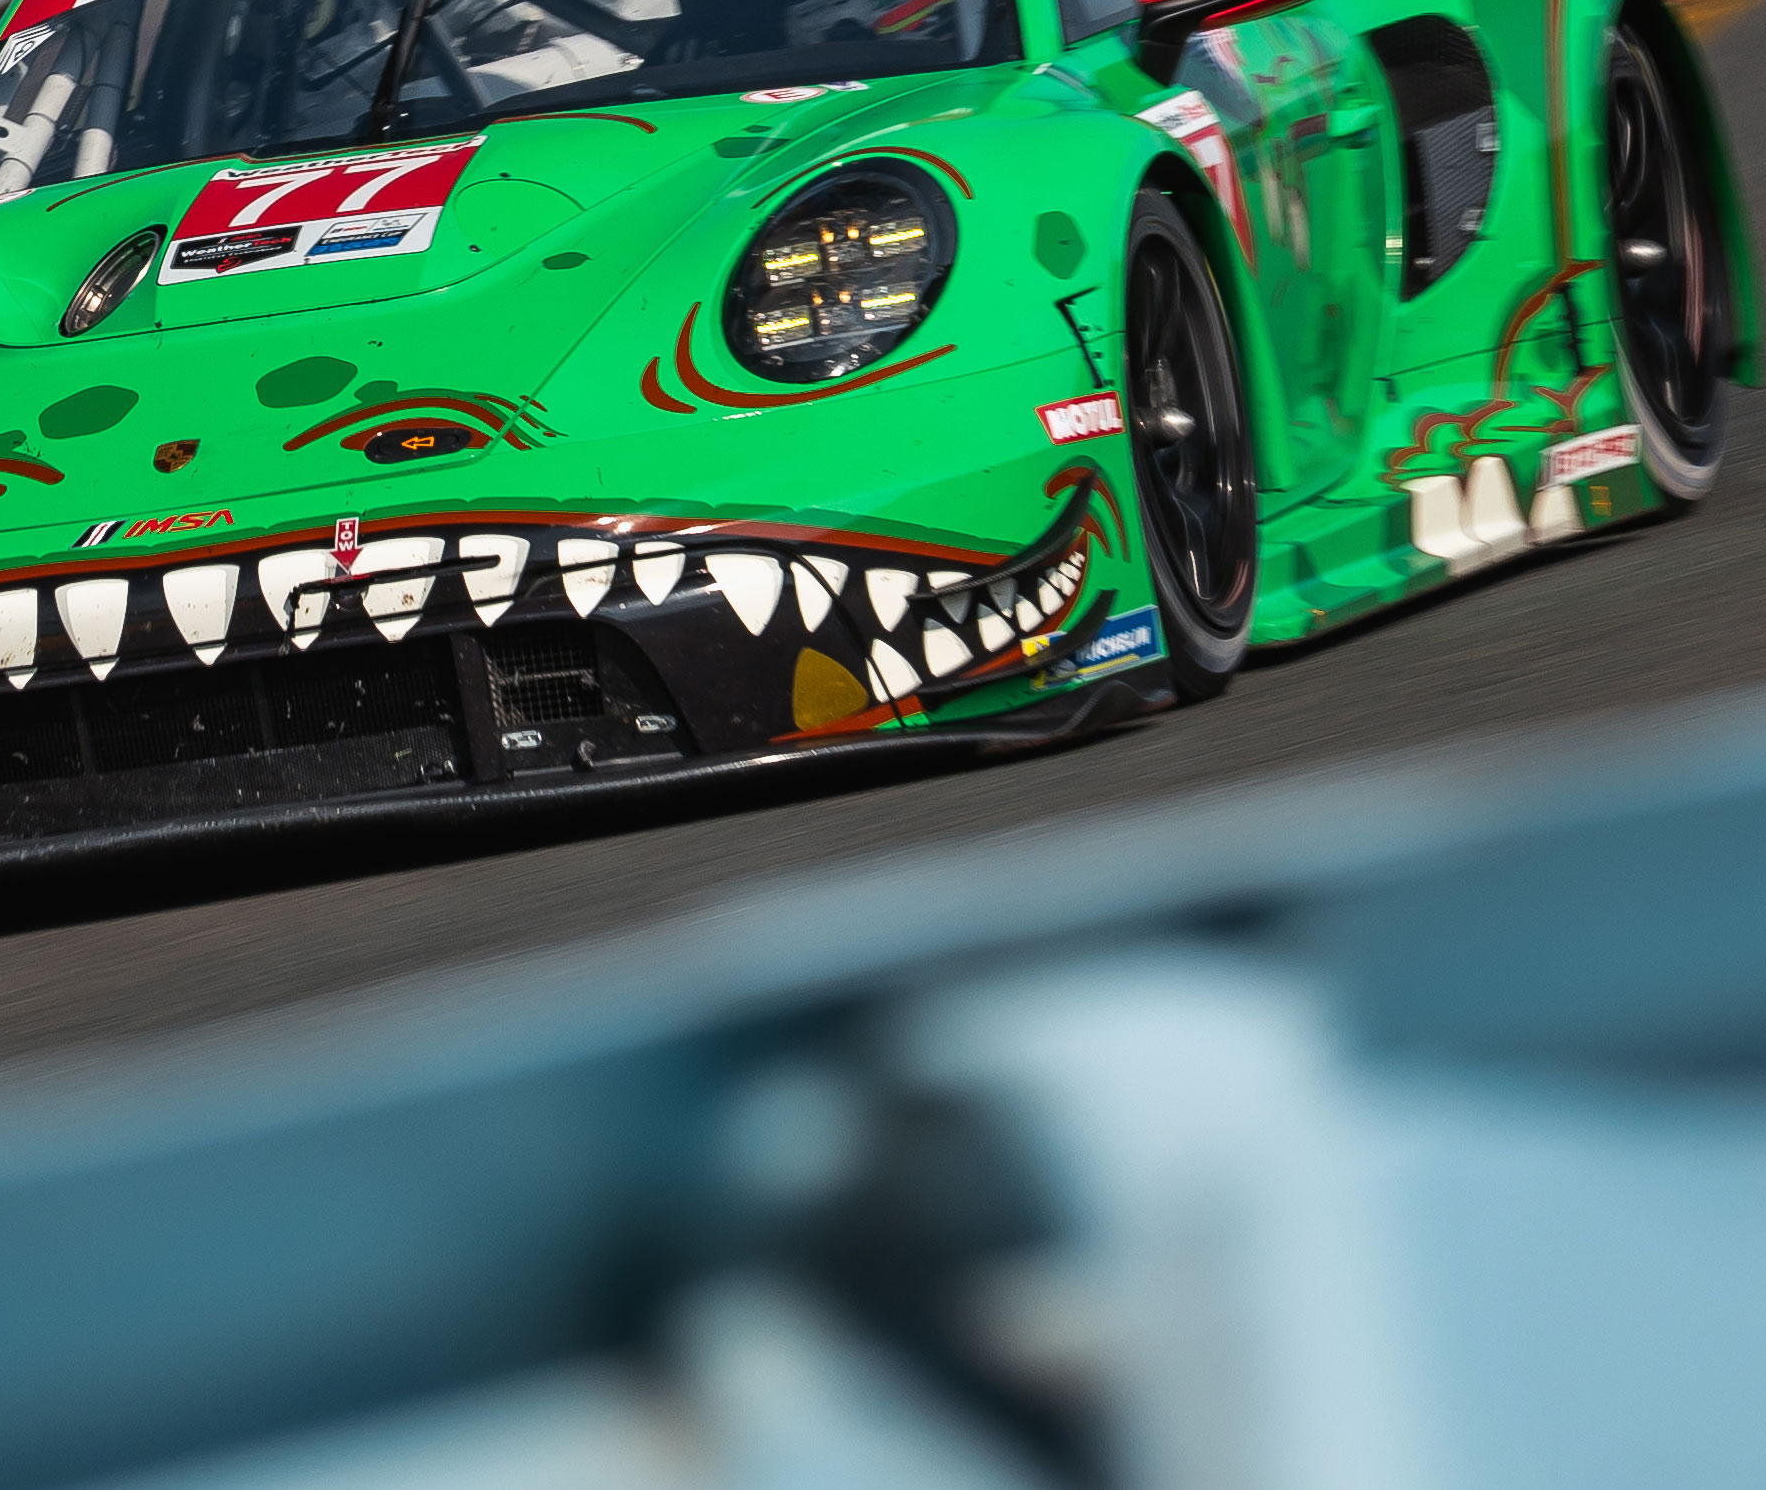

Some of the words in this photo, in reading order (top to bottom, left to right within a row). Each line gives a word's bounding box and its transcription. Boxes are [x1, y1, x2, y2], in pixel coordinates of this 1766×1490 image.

[228, 155, 443, 228] 77
[1044, 398, 1123, 440] MOTUL
[122, 508, 235, 540] IMSA
[338, 520, 355, 552] TOW
